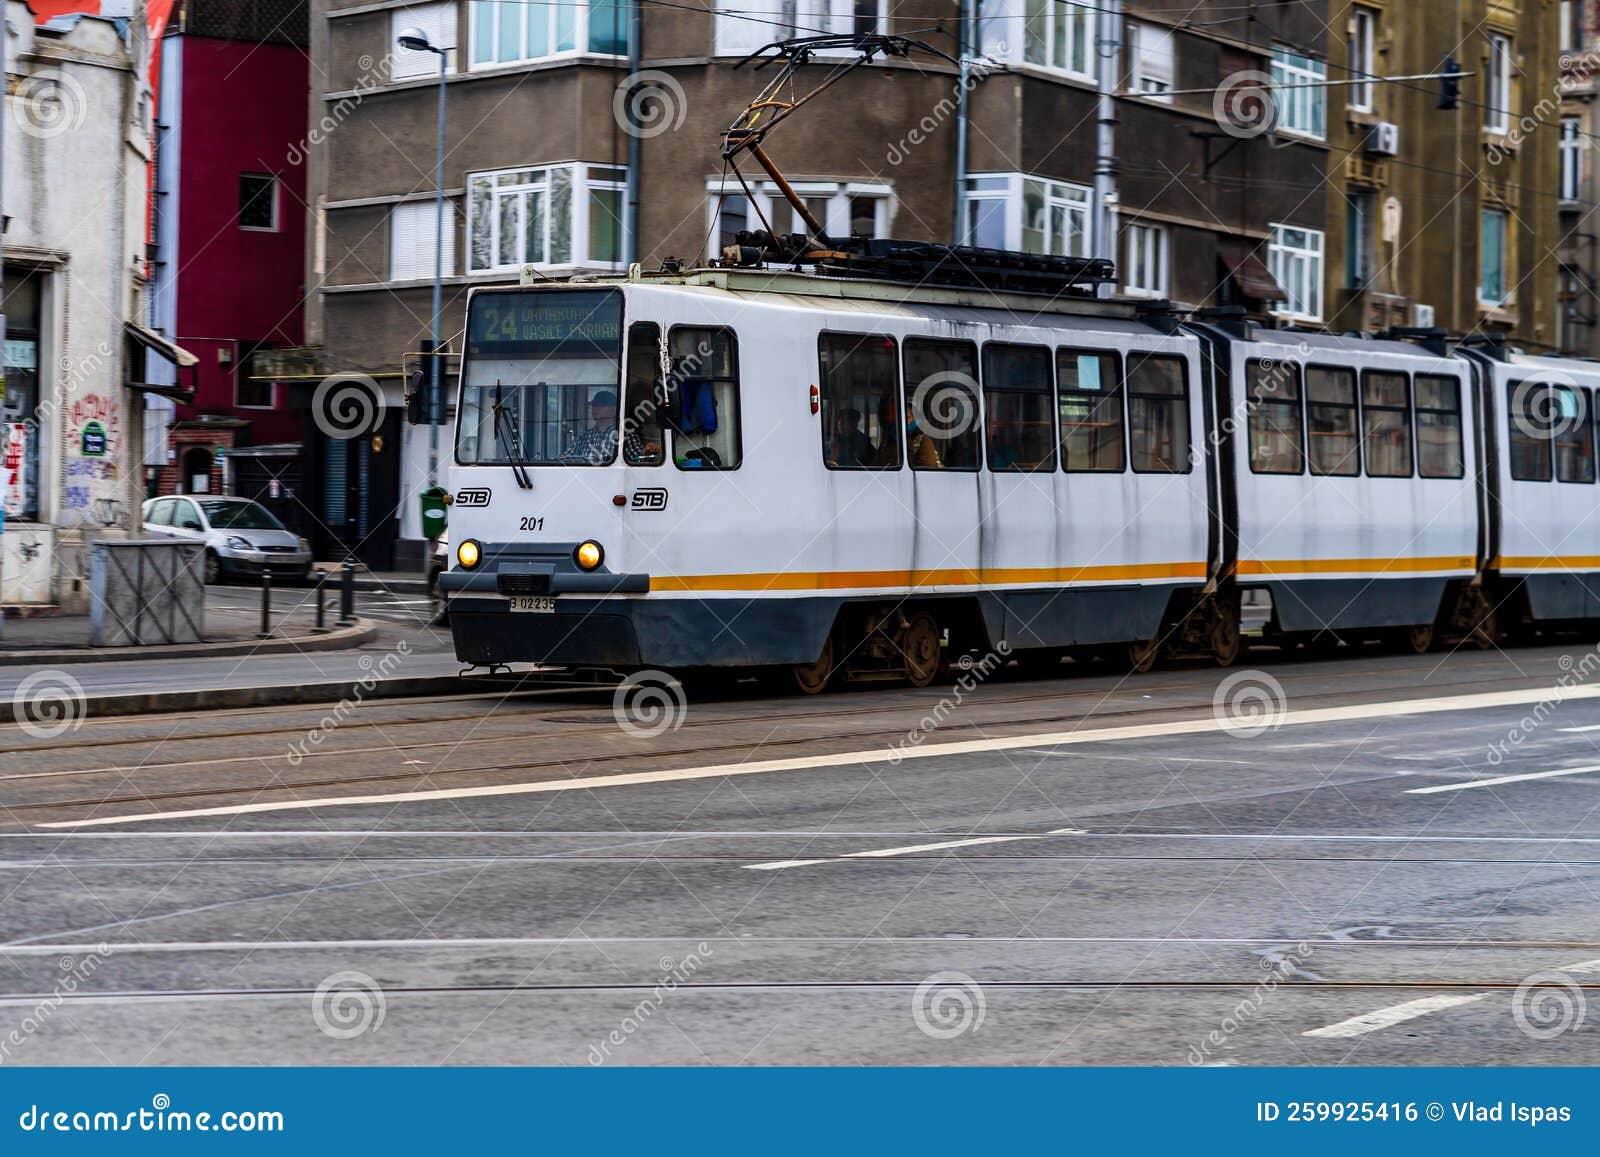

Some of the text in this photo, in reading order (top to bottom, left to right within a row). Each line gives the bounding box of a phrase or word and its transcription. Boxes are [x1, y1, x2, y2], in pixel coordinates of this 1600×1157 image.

[483, 308, 517, 341] 24
[456, 489, 490, 505] STB
[632, 490, 666, 508] STB
[519, 517, 545, 532] 201
